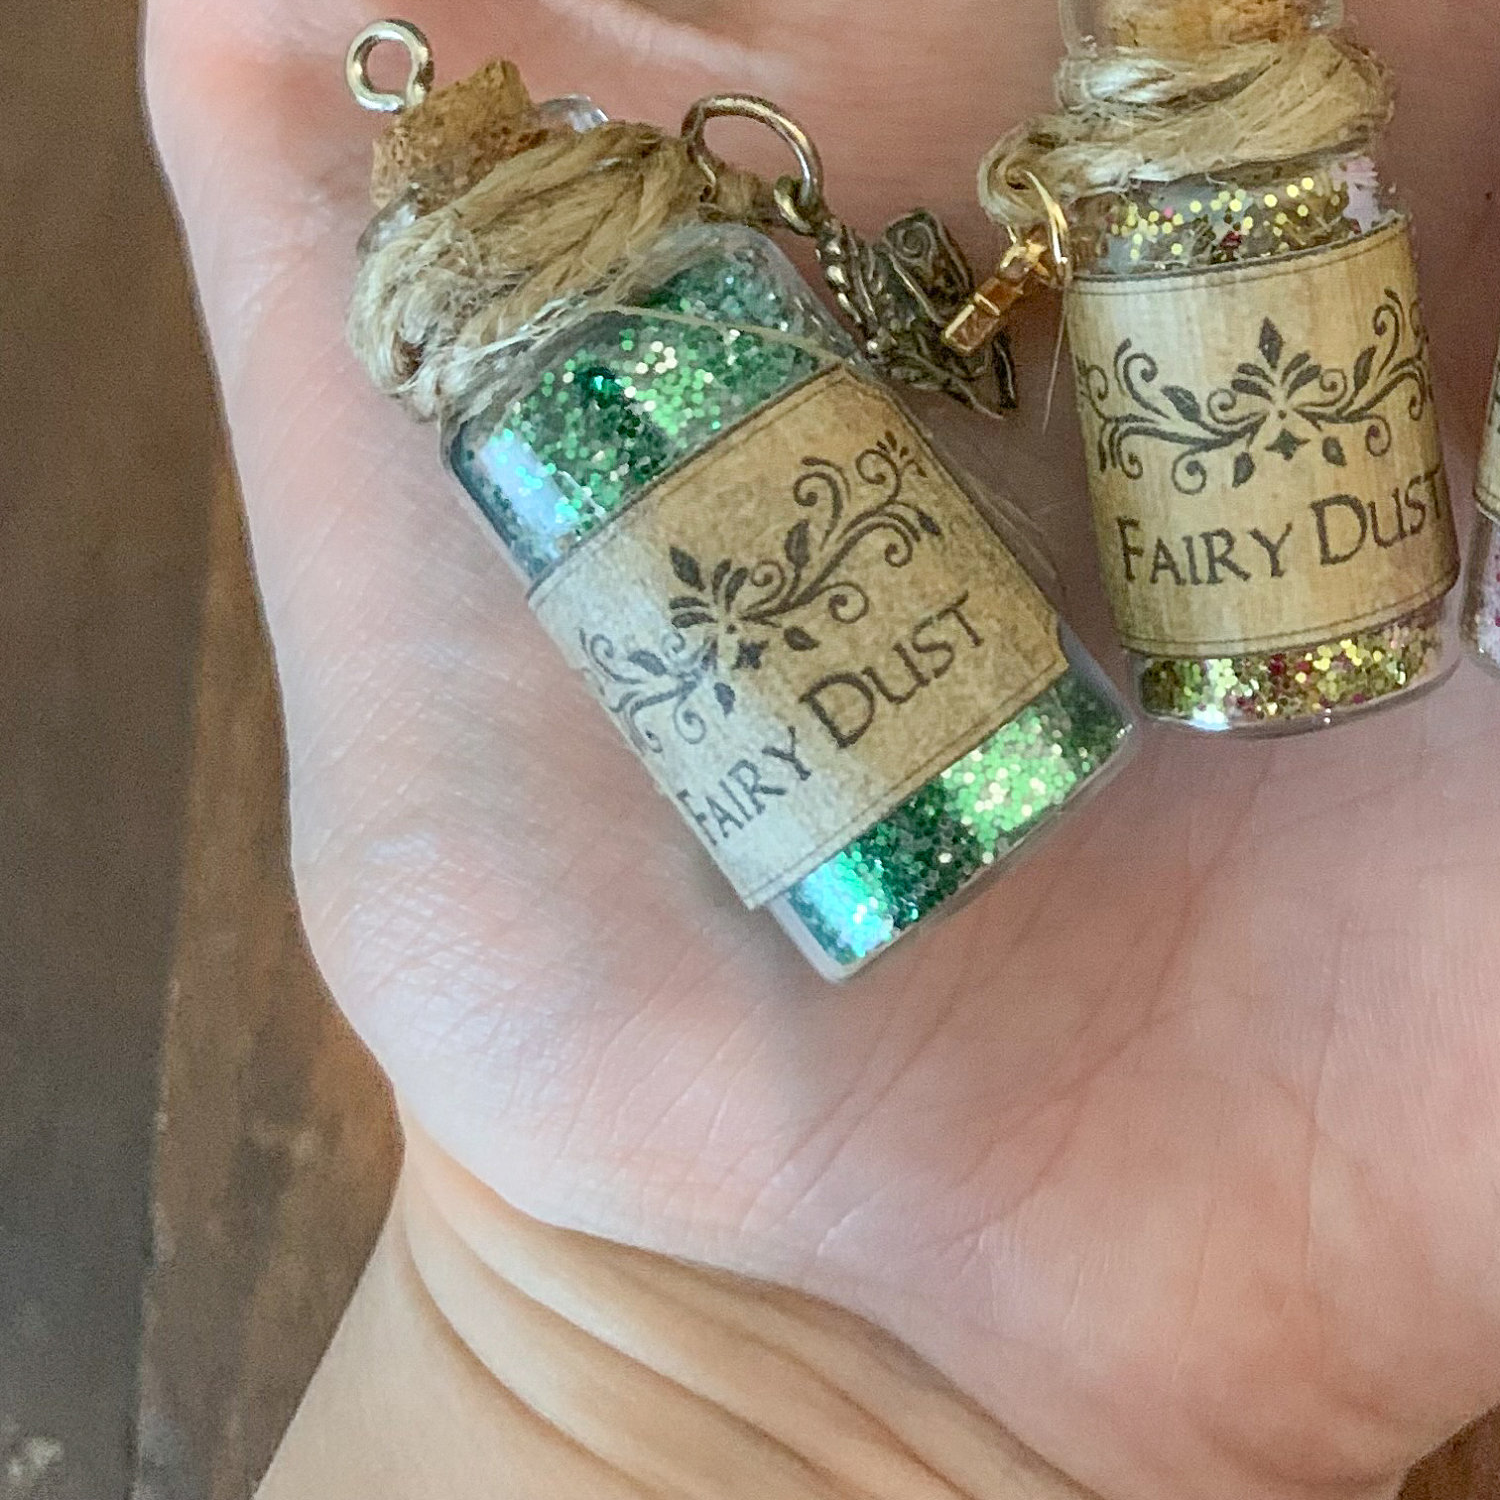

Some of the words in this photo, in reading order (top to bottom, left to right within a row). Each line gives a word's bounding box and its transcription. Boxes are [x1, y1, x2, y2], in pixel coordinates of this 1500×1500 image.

[1116, 516, 1293, 586] FAIRY
[1309, 467, 1443, 566] DUST
[676, 725, 812, 846] FAIRY
[799, 589, 984, 750] DUST
